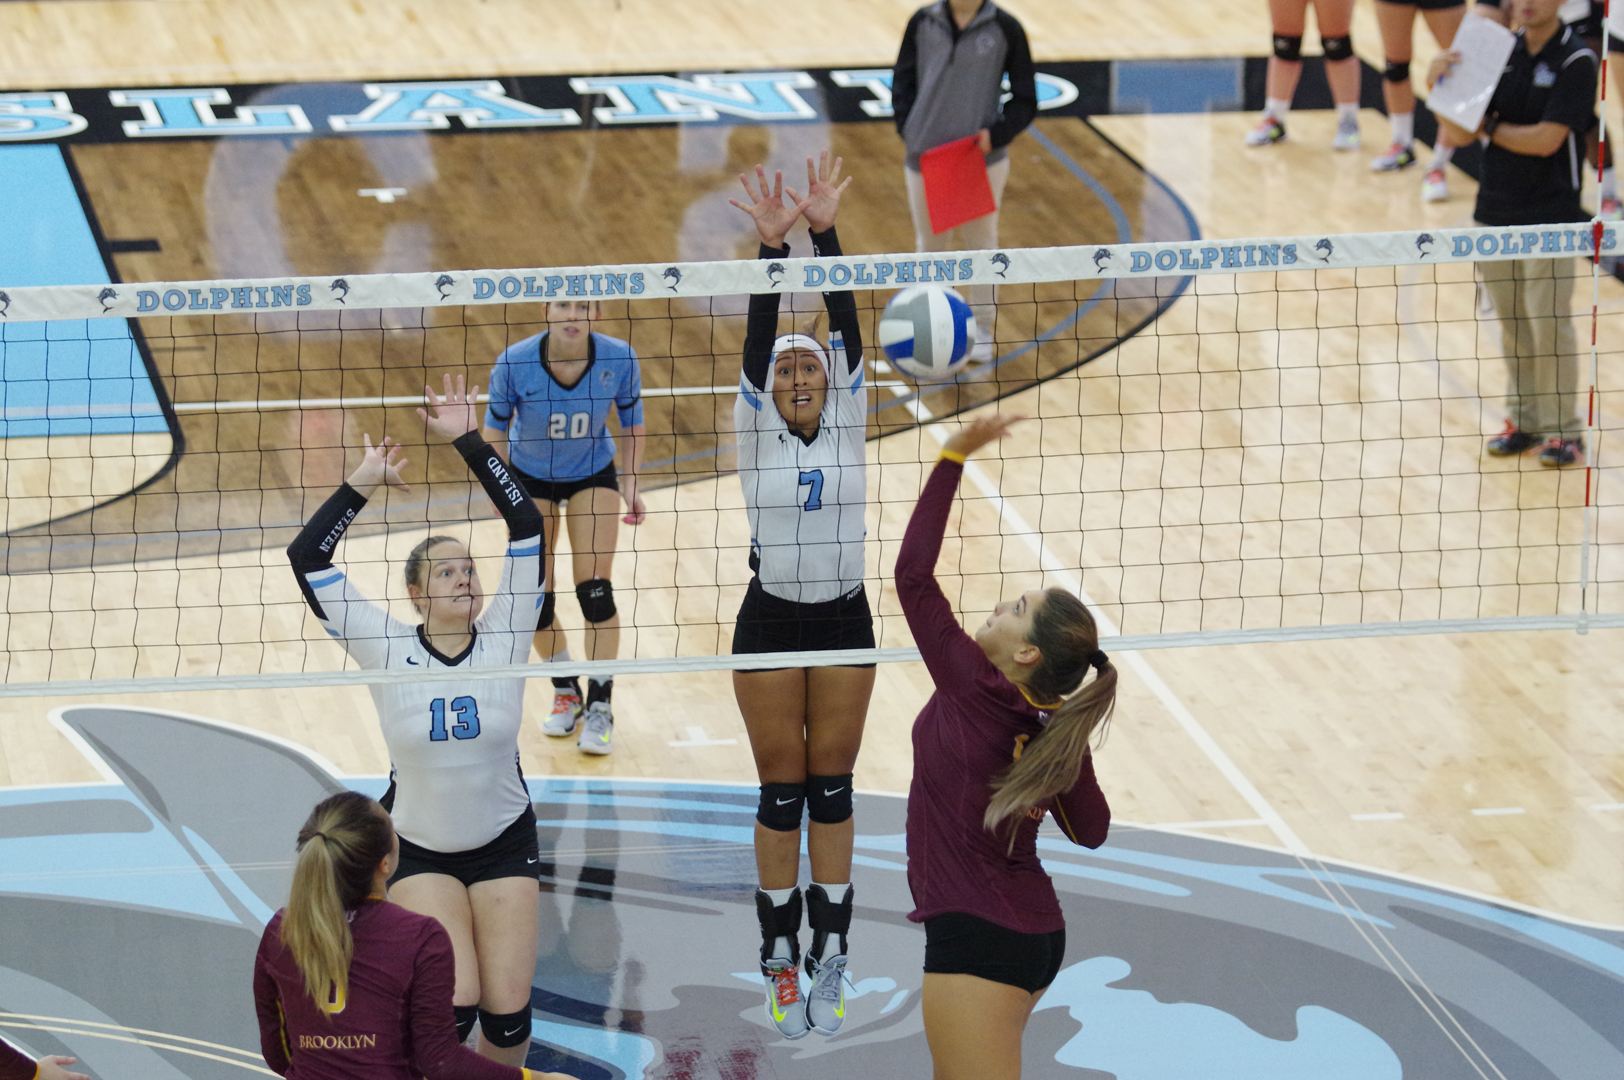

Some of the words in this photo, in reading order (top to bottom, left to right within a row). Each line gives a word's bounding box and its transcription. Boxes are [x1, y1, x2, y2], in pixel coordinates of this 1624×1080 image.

[136, 284, 312, 312] DOLPHINS
[472, 272, 645, 300] DOLPHINS
[803, 258, 973, 287] DOLPHINS
[1130, 243, 1298, 273] DOLPHINS
[1452, 229, 1616, 257] DOLPHINS
[546, 411, 590, 440] 20
[487, 456, 524, 507] ISLAND
[799, 469, 824, 511] 7
[319, 508, 356, 553] STATEN
[429, 695, 481, 742] 13
[299, 1033, 377, 1050] BROOKLYN
